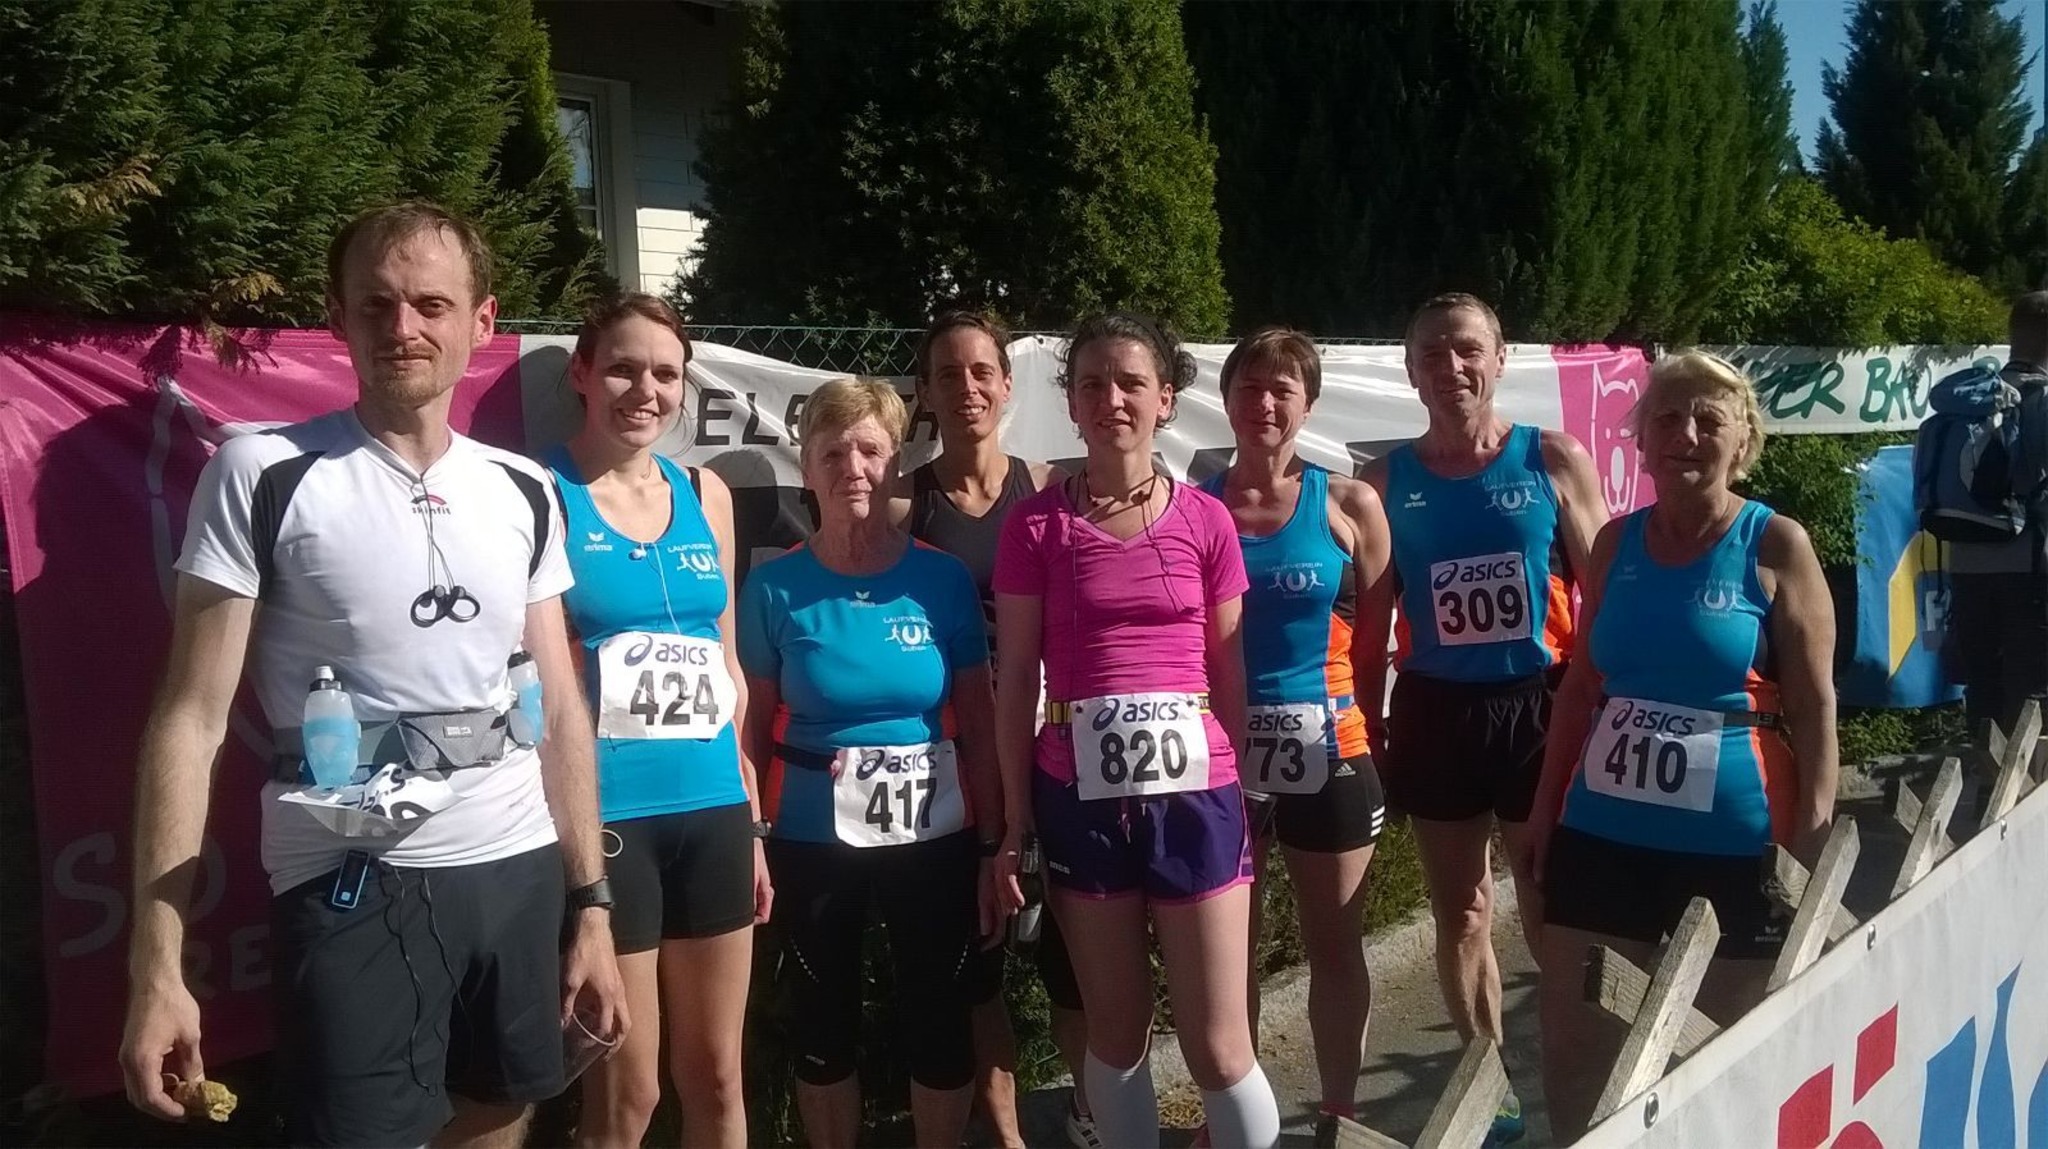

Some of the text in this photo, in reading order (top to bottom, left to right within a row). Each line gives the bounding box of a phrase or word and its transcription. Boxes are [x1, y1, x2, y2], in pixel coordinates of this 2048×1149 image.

[1460, 560, 1516, 583] asics
[1439, 584, 1524, 635] 309
[655, 643, 708, 666] asics
[629, 670, 719, 726] 424
[1122, 702, 1179, 723] asics
[1248, 713, 1303, 732] asics
[1632, 709, 1696, 736] asics
[886, 751, 938, 773] asics
[1100, 729, 1188, 785] 820
[1244, 737, 1306, 783] 73
[1604, 733, 1688, 794] 410
[865, 777, 937, 833] 417
